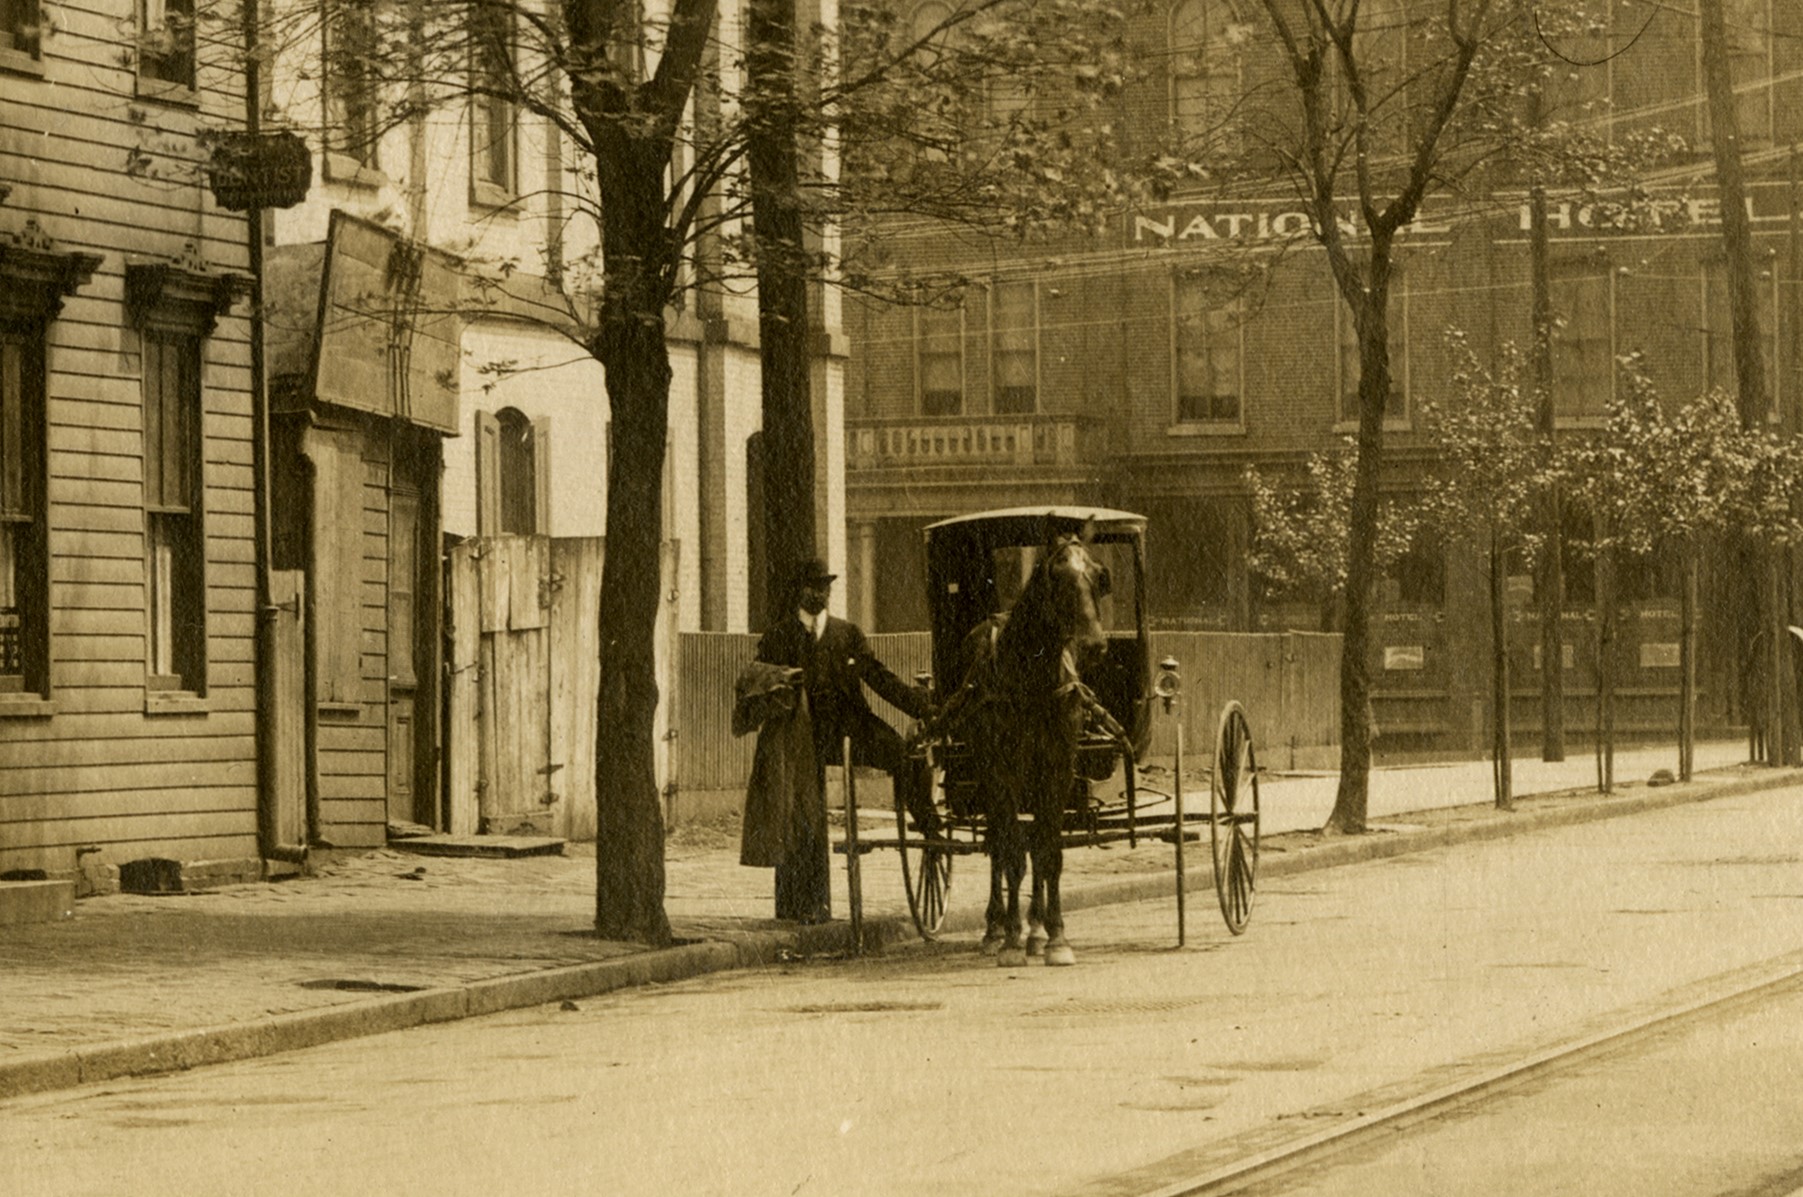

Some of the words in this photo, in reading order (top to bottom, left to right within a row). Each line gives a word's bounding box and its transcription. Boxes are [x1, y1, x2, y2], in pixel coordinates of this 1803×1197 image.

[1134, 205, 1451, 240] NATIONL
[1519, 197, 1791, 231] HOTEL
[1384, 613, 1422, 621] HOTEL
